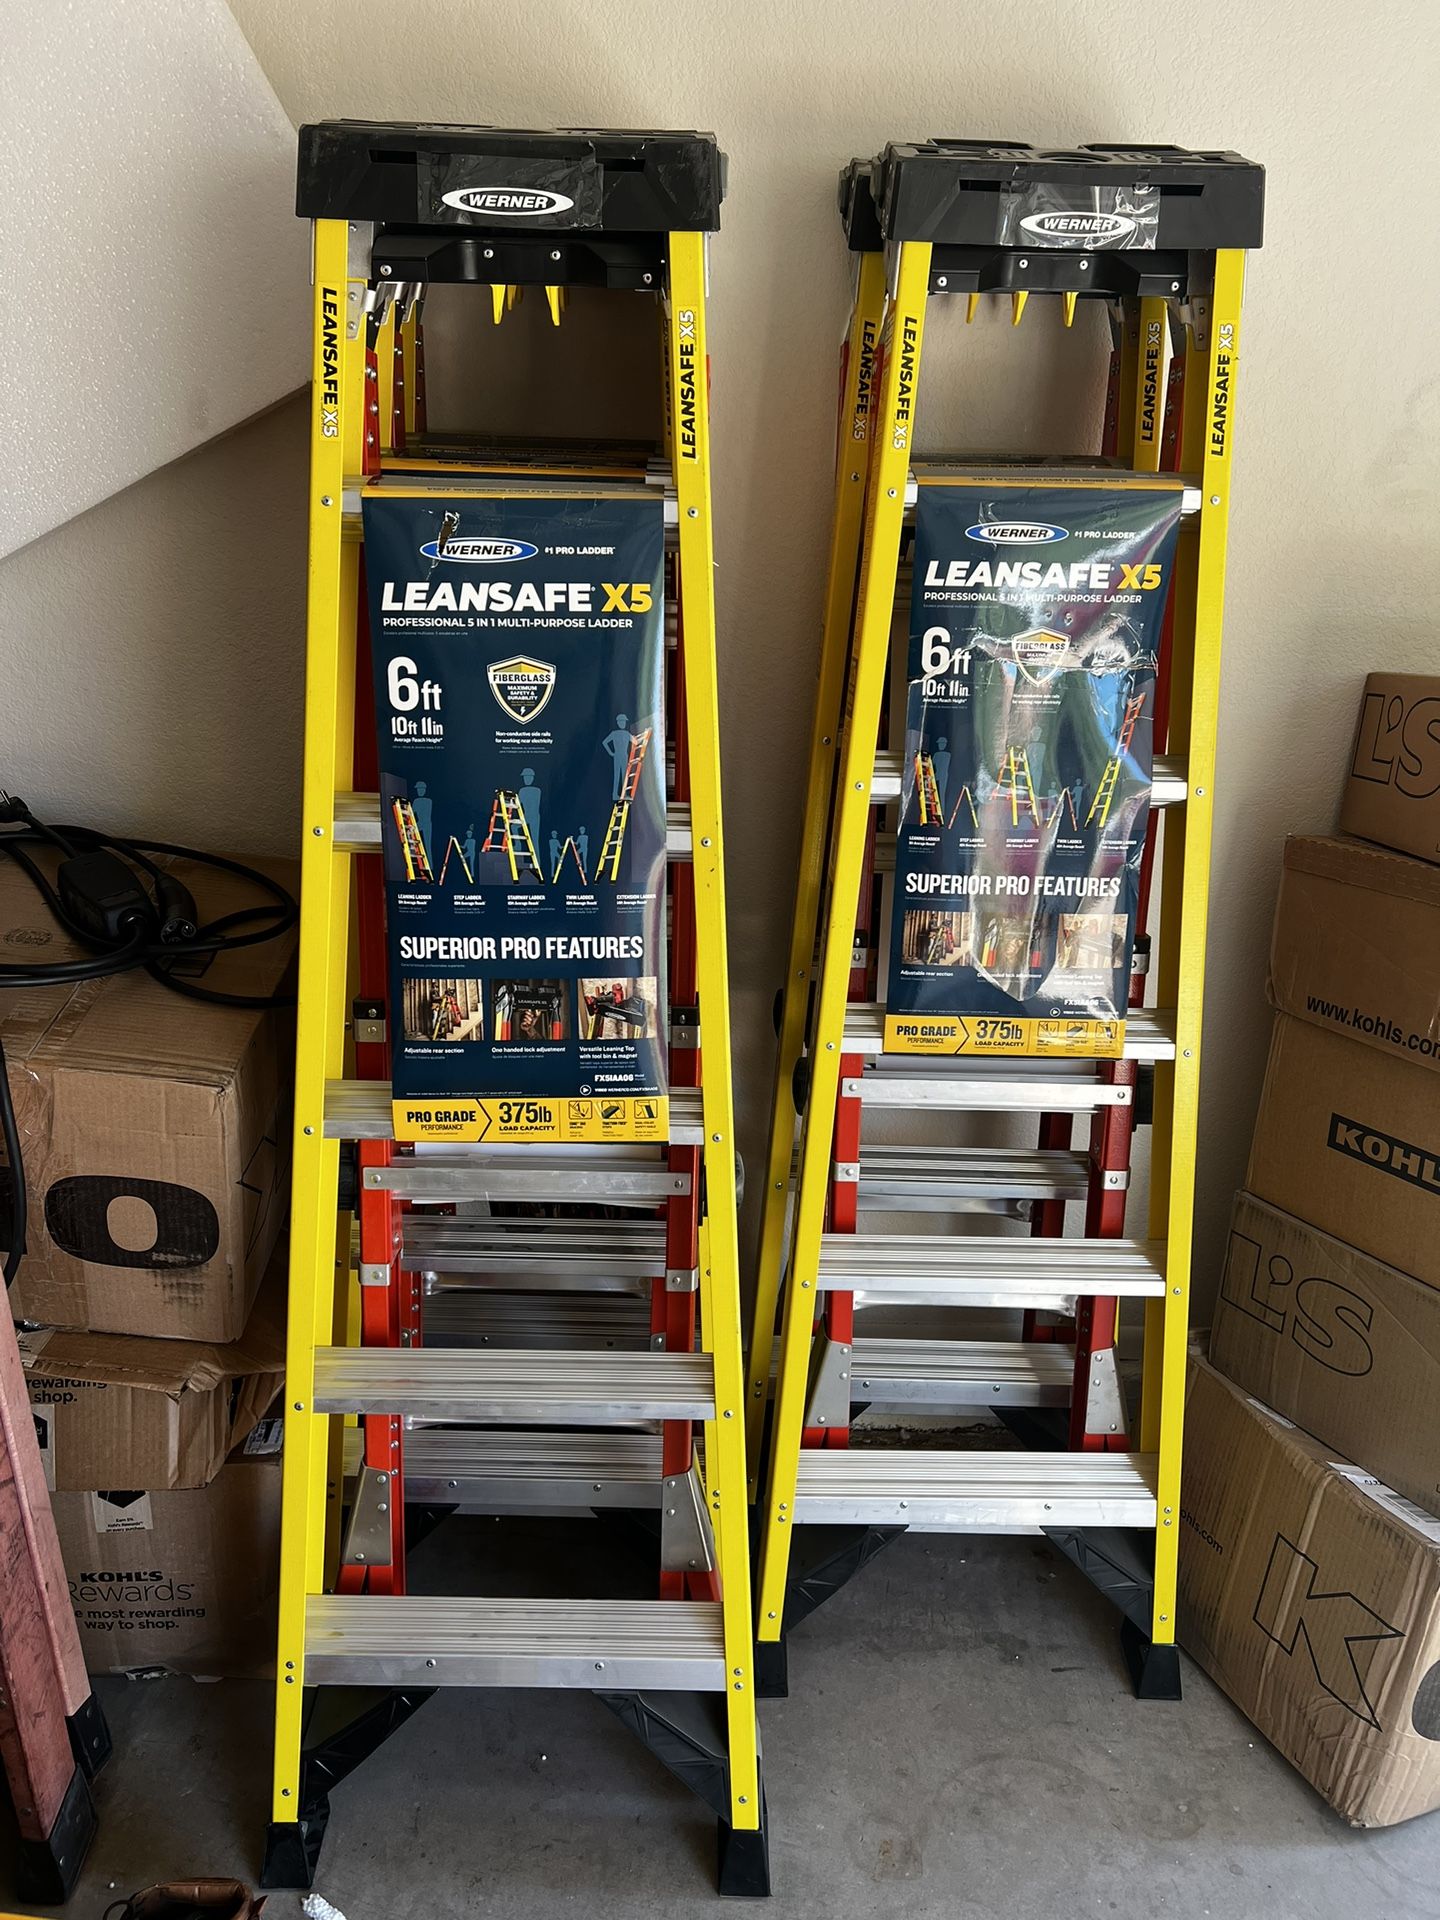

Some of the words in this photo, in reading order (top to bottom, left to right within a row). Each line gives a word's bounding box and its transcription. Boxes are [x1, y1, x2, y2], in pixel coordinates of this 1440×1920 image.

[469, 194, 548, 208] WERNER
[1044, 218, 1114, 231] WERNER
[680, 310, 695, 339] X5
[1147, 322, 1160, 345] X5
[323, 287, 338, 405] LEANSAFE
[1218, 323, 1233, 350] X5
[856, 320, 876, 414] LEANSAFE
[896, 316, 917, 420] LEANSAFE
[680, 343, 696, 459] LEANSAFE
[1141, 349, 1158, 442] LEANSAFE
[1211, 354, 1230, 456] LEANSAFE
[323, 409, 338, 438] X5
[853, 418, 867, 440] X5
[893, 424, 908, 449] X5
[987, 528, 1048, 538] WERNER
[1103, 531, 1135, 539] LADDER
[445, 545, 515, 555] WERNER
[544, 546, 554, 554] #1
[555, 546, 574, 554] PRO
[577, 547, 614, 555] LADDER
[924, 560, 1112, 589] LEANSAFE
[1117, 563, 1162, 590] X5
[381, 582, 594, 613] LEANSAFE
[600, 583, 653, 613] X5
[924, 592, 998, 601] PROFESSIONAL
[1104, 594, 1142, 603] LADDER
[383, 617, 466, 627] PROFESSIONAL
[467, 618, 475, 627] 5
[477, 618, 488, 627] IN
[490, 618, 495, 627] 1
[498, 618, 586, 628] MULTI-PURPOSE
[588, 618, 633, 628] LADDER
[493, 674, 551, 682] FIBERGLASS
[391, 716, 417, 735] 10ft
[905, 872, 991, 896] SUPERIOR
[994, 875, 1030, 896] PRO
[1033, 876, 1121, 898] FEATURES
[400, 936, 496, 960] SUPERIOR
[501, 936, 540, 959] PRO
[545, 935, 643, 959] FEATURES
[896, 1025, 919, 1036] PRO
[921, 1026, 957, 1037] GRADE
[976, 1020, 1023, 1040] 375lb
[1307, 996, 1440, 1059] www.kohls.co
[407, 1111, 431, 1123] PRO
[435, 1110, 477, 1122] GRADE
[499, 1102, 552, 1124] 375lb
[421, 1123, 464, 1131] PERFORMANCE
[1336, 1121, 1440, 1187] KOHL
[1221, 1230, 1373, 1377] L'S
[34, 1391, 77, 1404] shop.
[1180, 1509, 1223, 1556] ohls.com
[80, 1571, 163, 1582] KOHL'S
[68, 1579, 192, 1602] Rewards
[88, 1609, 124, 1618] most
[129, 1607, 206, 1618] rewarding
[85, 1621, 114, 1631] way
[118, 1620, 134, 1630] to
[138, 1620, 179, 1630] shop.
[1254, 1533, 1405, 1733] K
